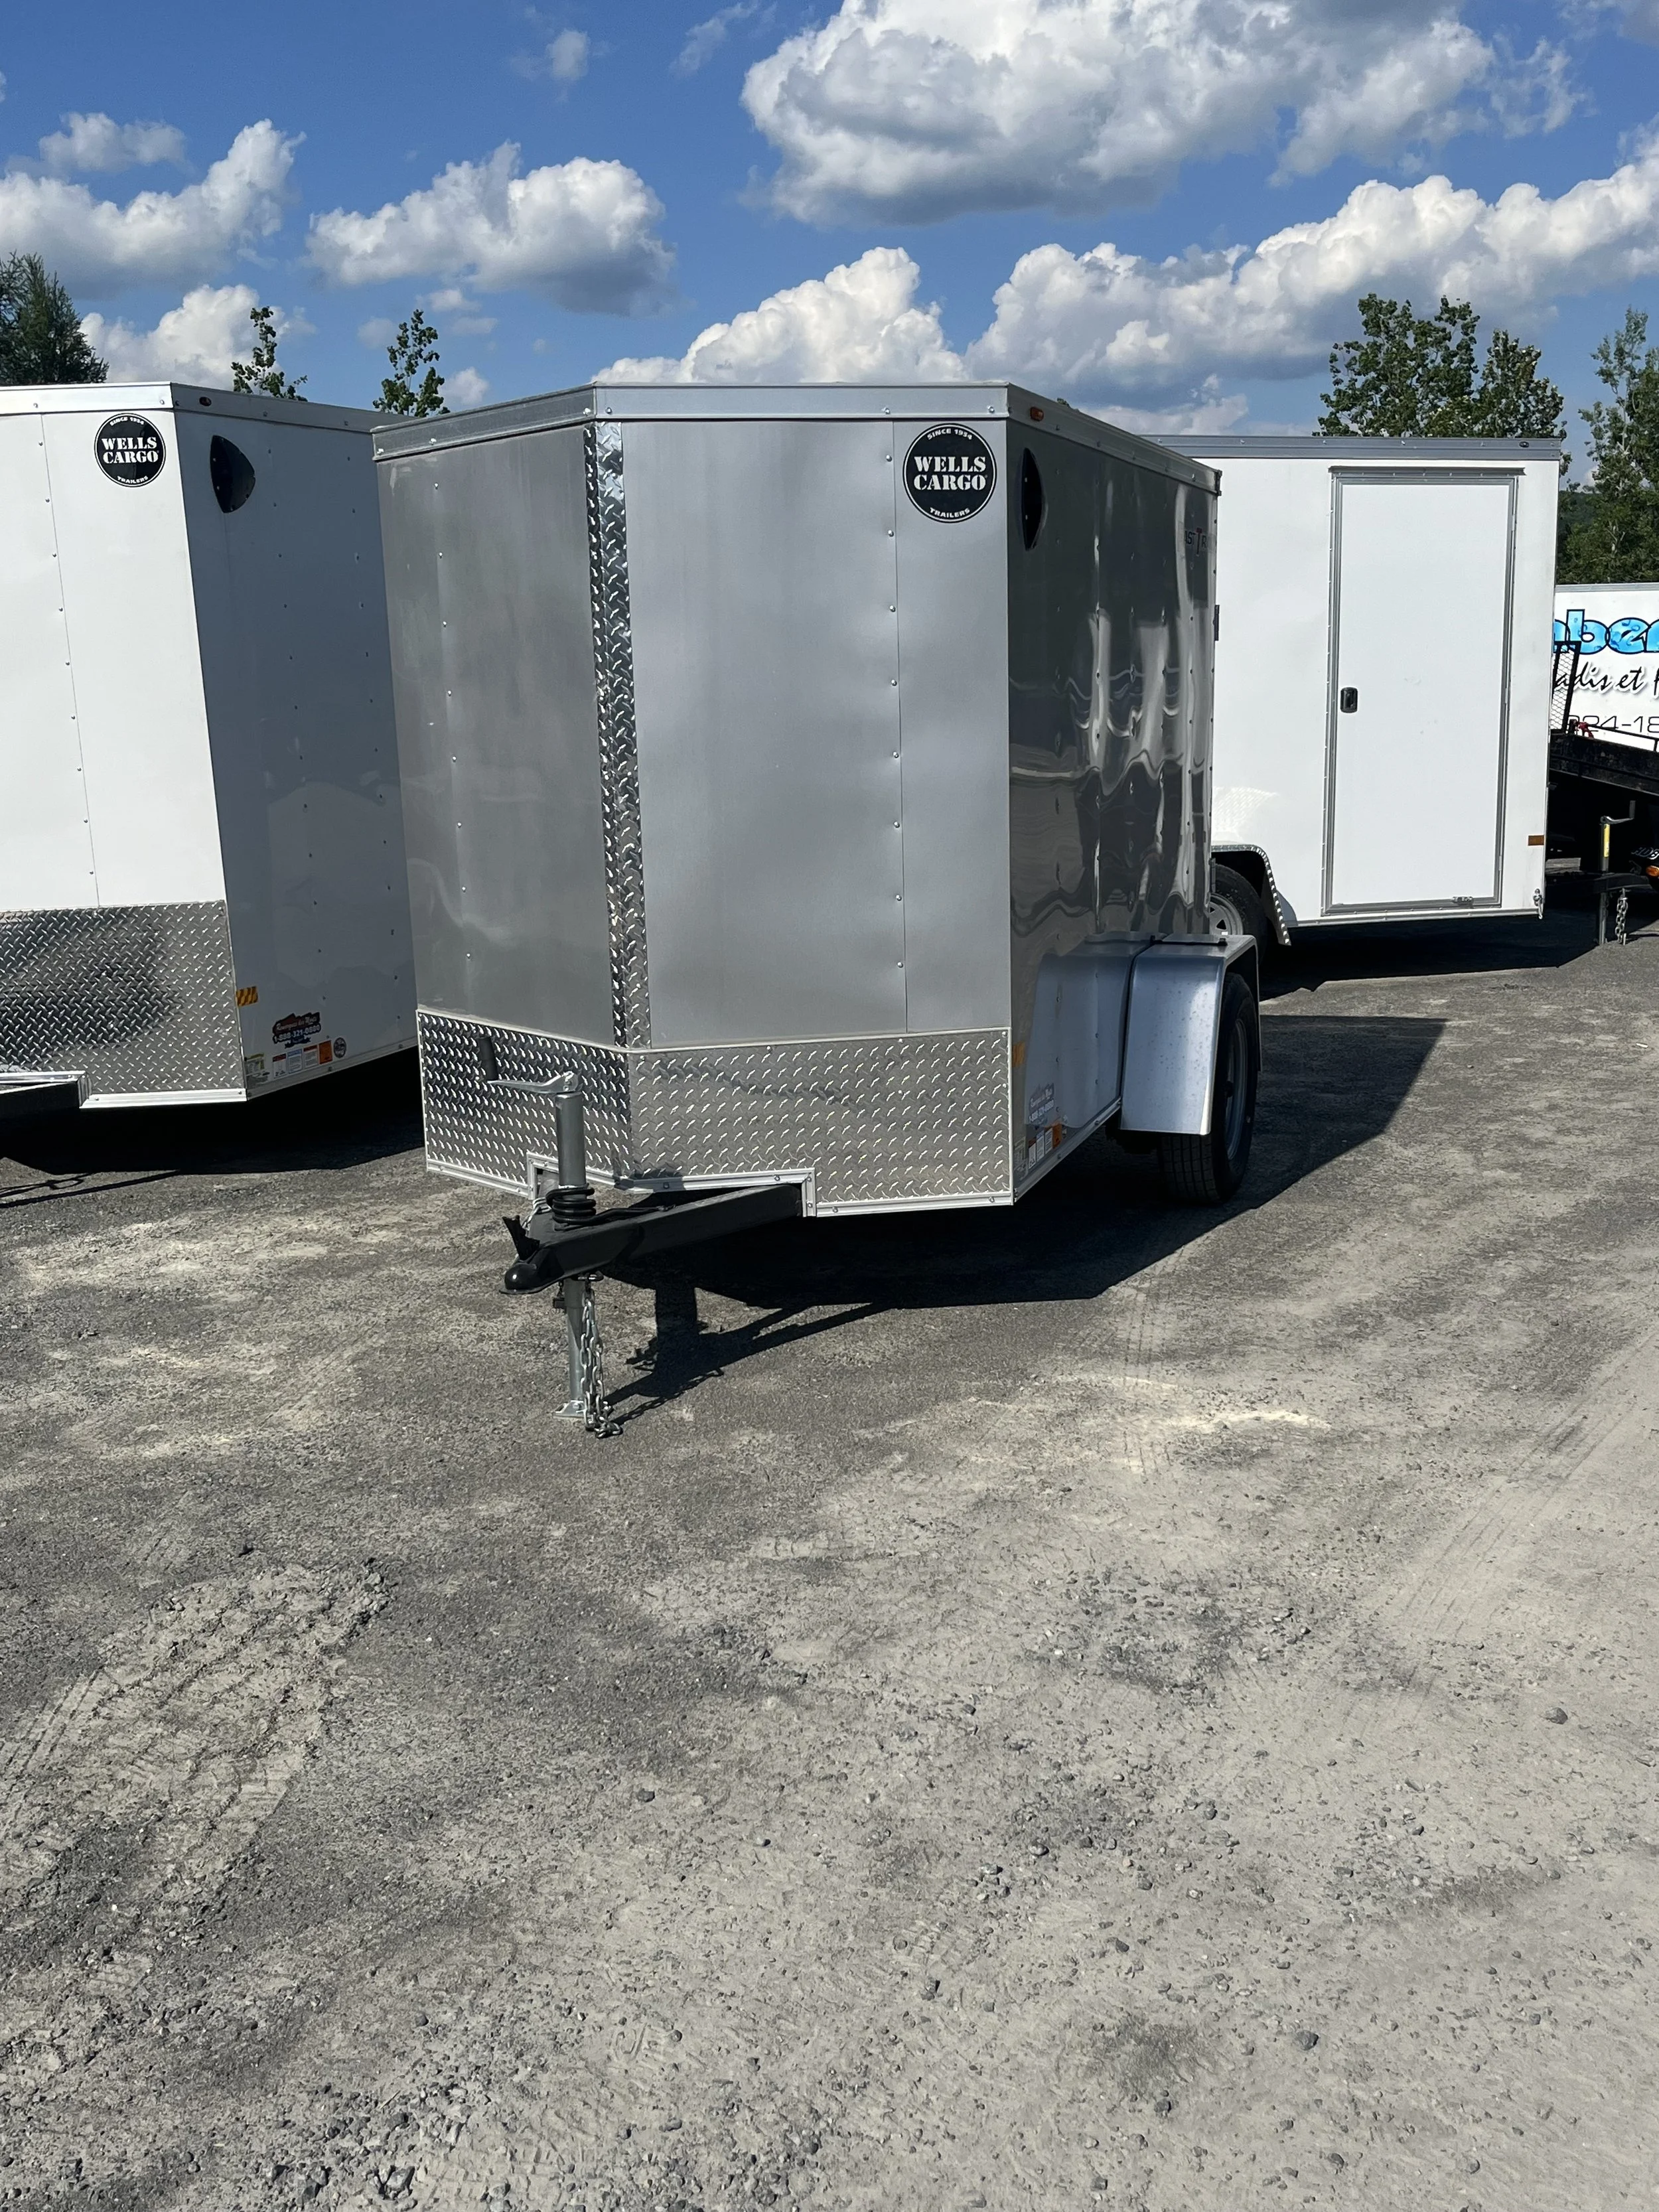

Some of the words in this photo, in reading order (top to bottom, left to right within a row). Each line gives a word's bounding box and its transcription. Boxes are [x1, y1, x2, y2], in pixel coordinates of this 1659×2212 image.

[927, 428, 952, 440] SINCE
[101, 437, 157, 450] WELLS
[103, 451, 159, 464] CARGO
[914, 457, 986, 472] WELLS
[117, 475, 149, 484] TRAILERS
[914, 475, 986, 490] CARGO
[930, 507, 970, 518] TRAILERS
[1616, 666, 1644, 690] et
